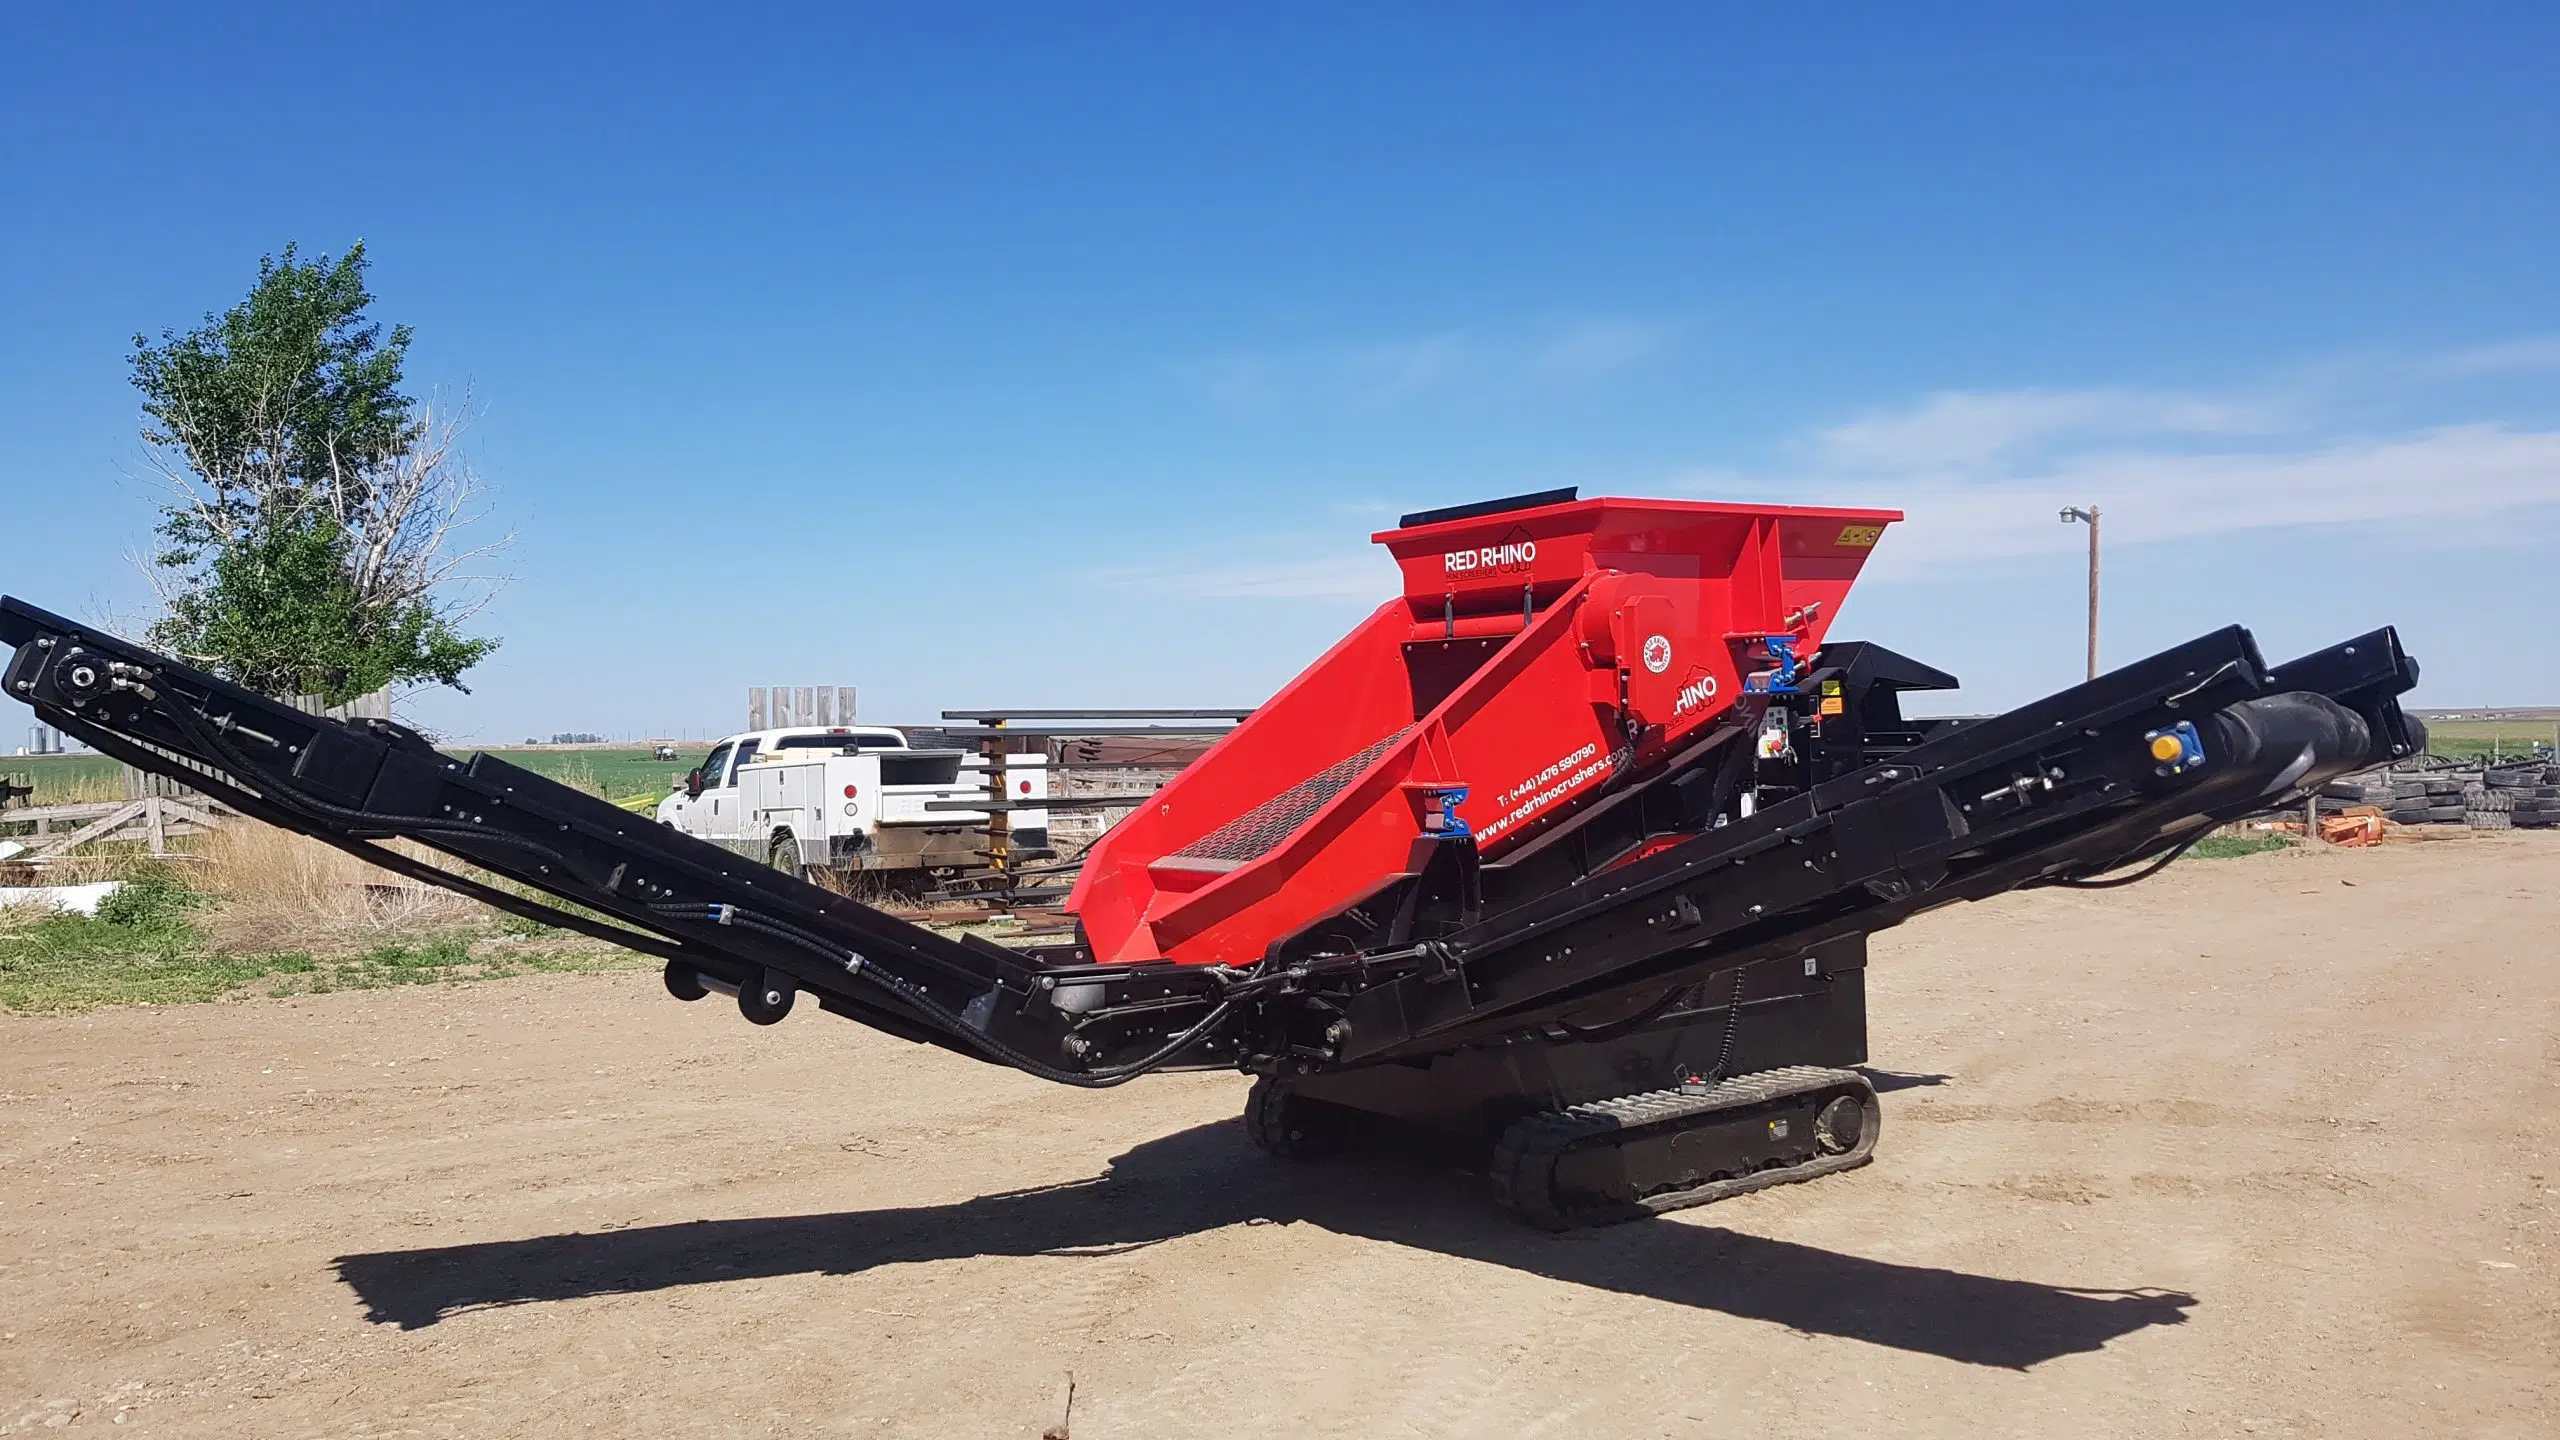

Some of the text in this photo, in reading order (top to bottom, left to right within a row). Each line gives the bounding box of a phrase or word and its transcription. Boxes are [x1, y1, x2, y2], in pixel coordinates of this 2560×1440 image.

[1445, 541, 1536, 572] RED RHINO
[1673, 676, 1717, 715] HINO
[1497, 743, 1596, 807] T: (+44) 1476 590790
